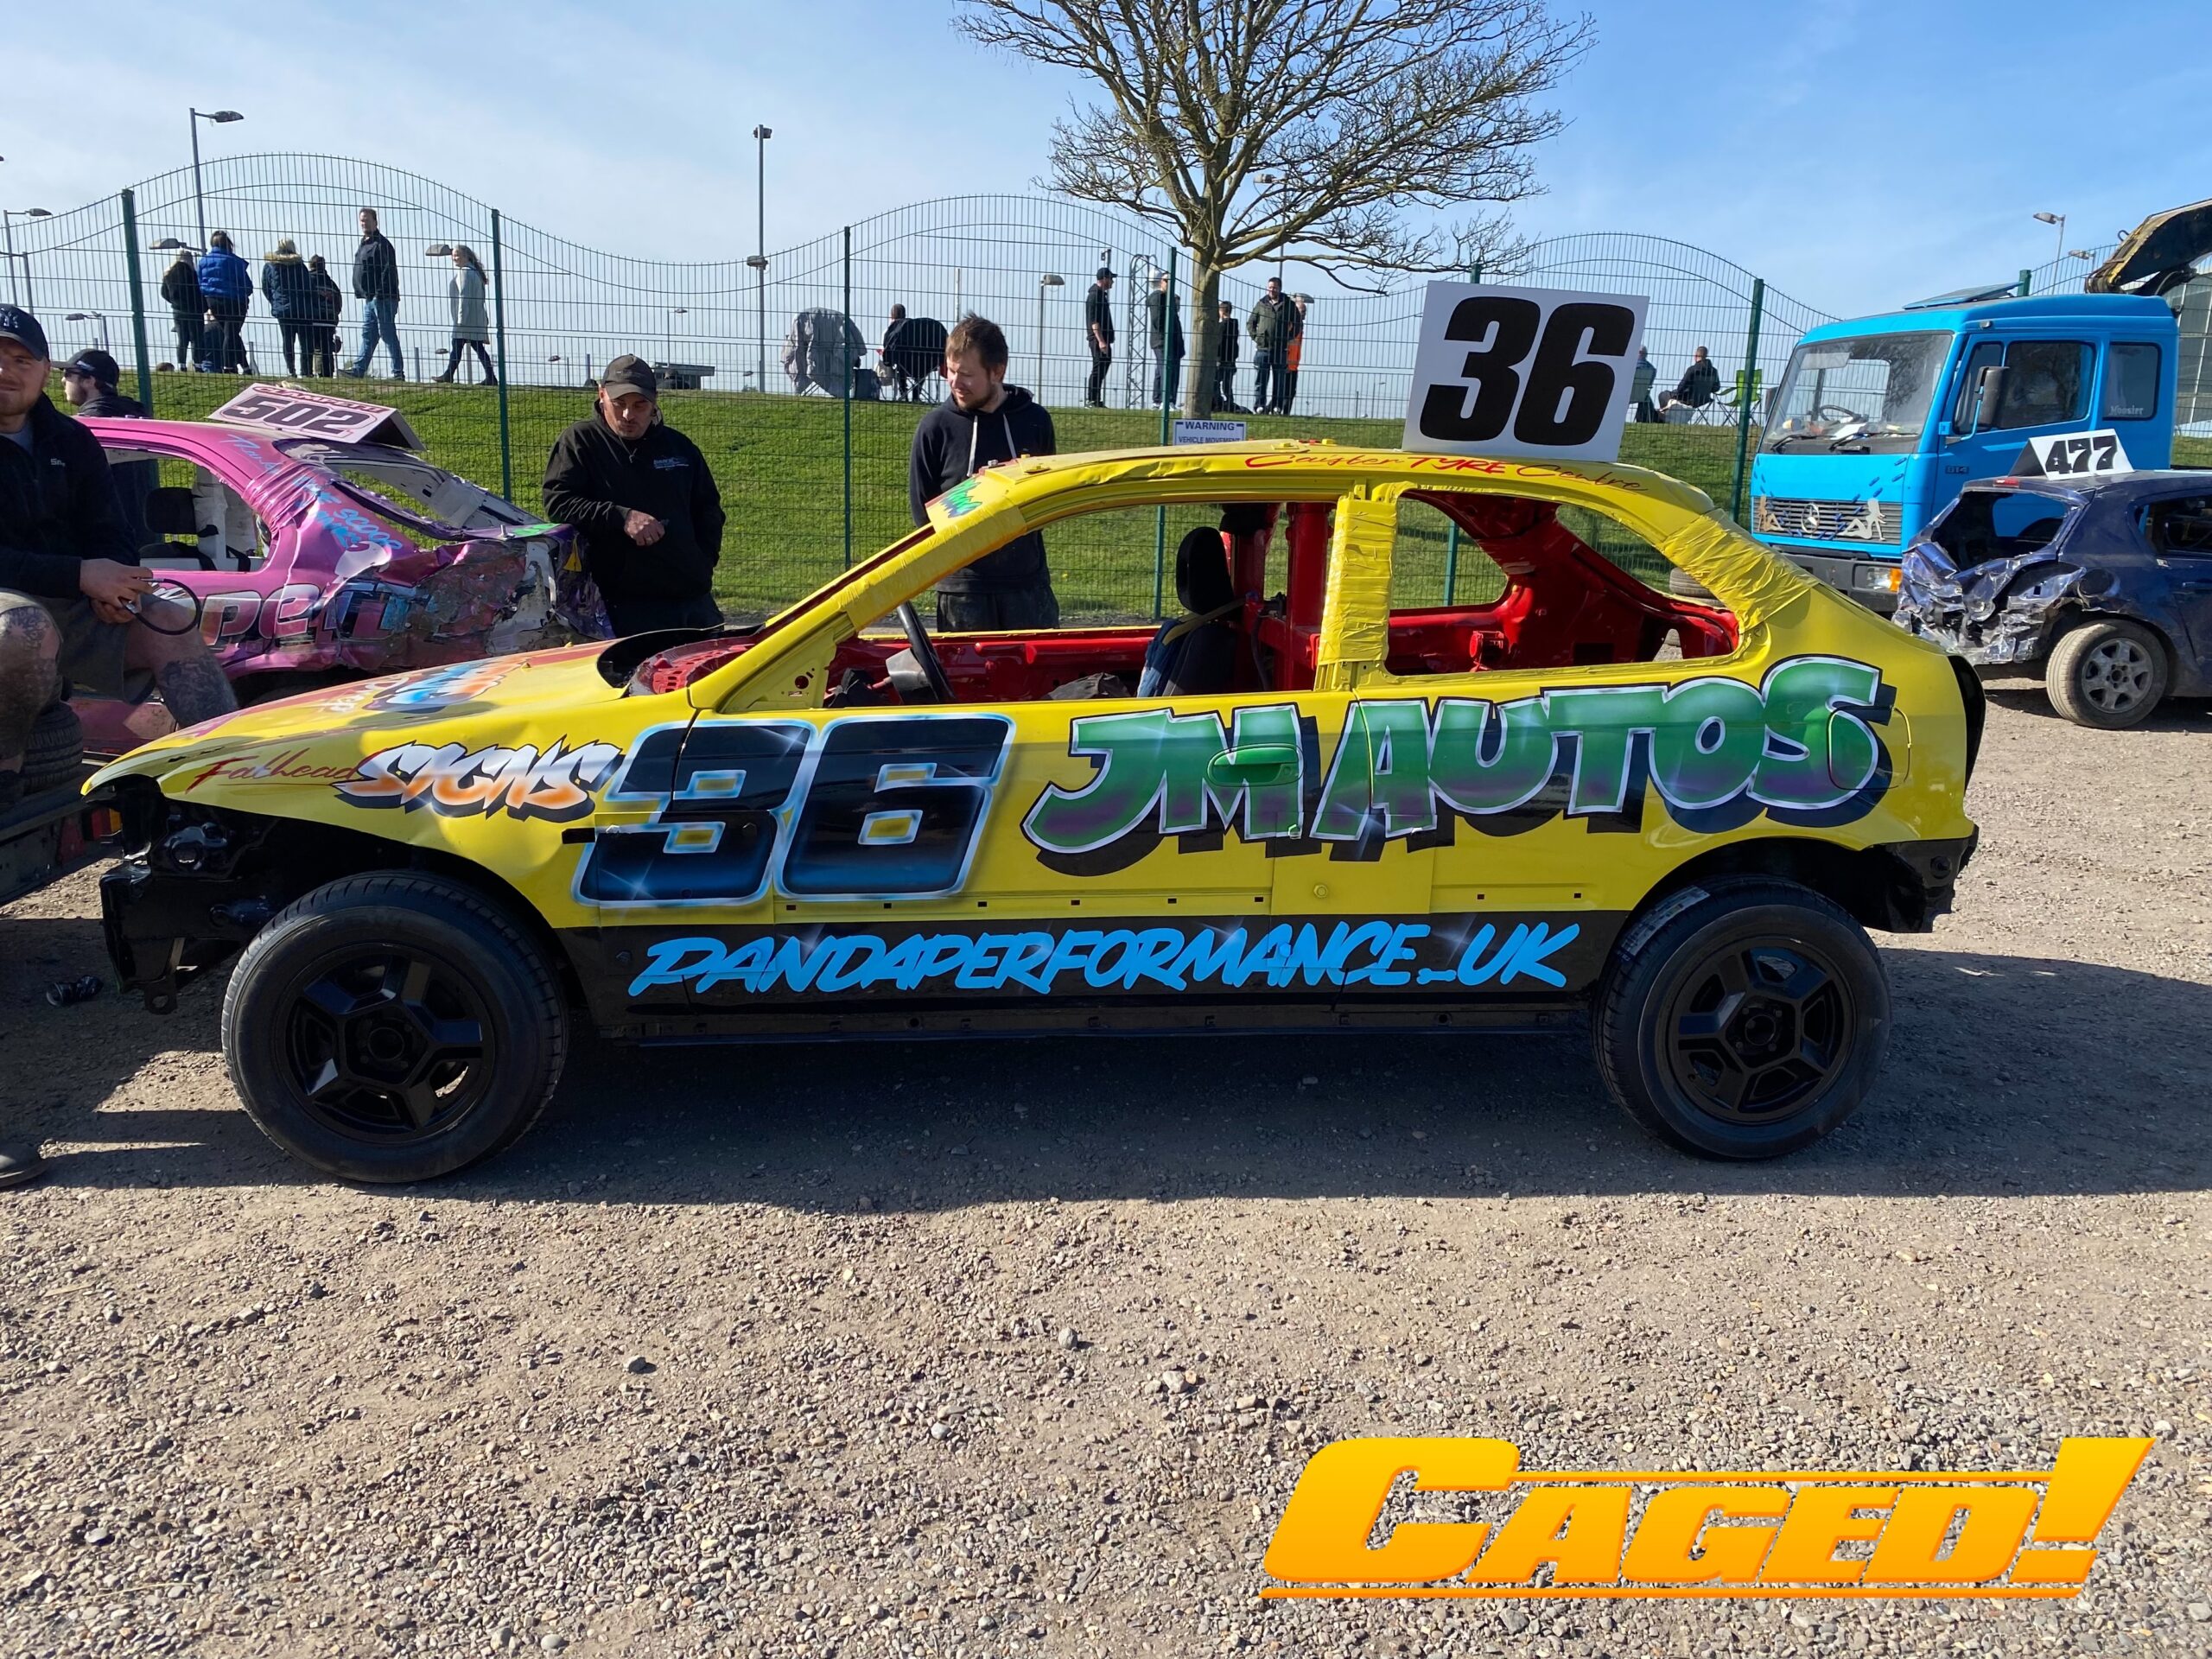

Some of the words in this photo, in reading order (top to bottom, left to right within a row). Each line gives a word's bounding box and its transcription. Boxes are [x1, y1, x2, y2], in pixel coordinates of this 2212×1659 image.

[1420, 296, 1636, 446] 36
[222, 395, 371, 435] 502
[1185, 421, 1236, 431] WARNING
[1178, 435, 1204, 444] VEHICLE
[2045, 435, 2118, 474] 477
[1407, 455, 1509, 474] TYRE
[1516, 463, 1649, 492] Centre
[1021, 702, 1303, 855] JM
[1310, 654, 1884, 849] AUTOS
[185, 747, 387, 795] Fathead
[331, 734, 622, 817] SIGNS
[571, 713, 1017, 908] 36
